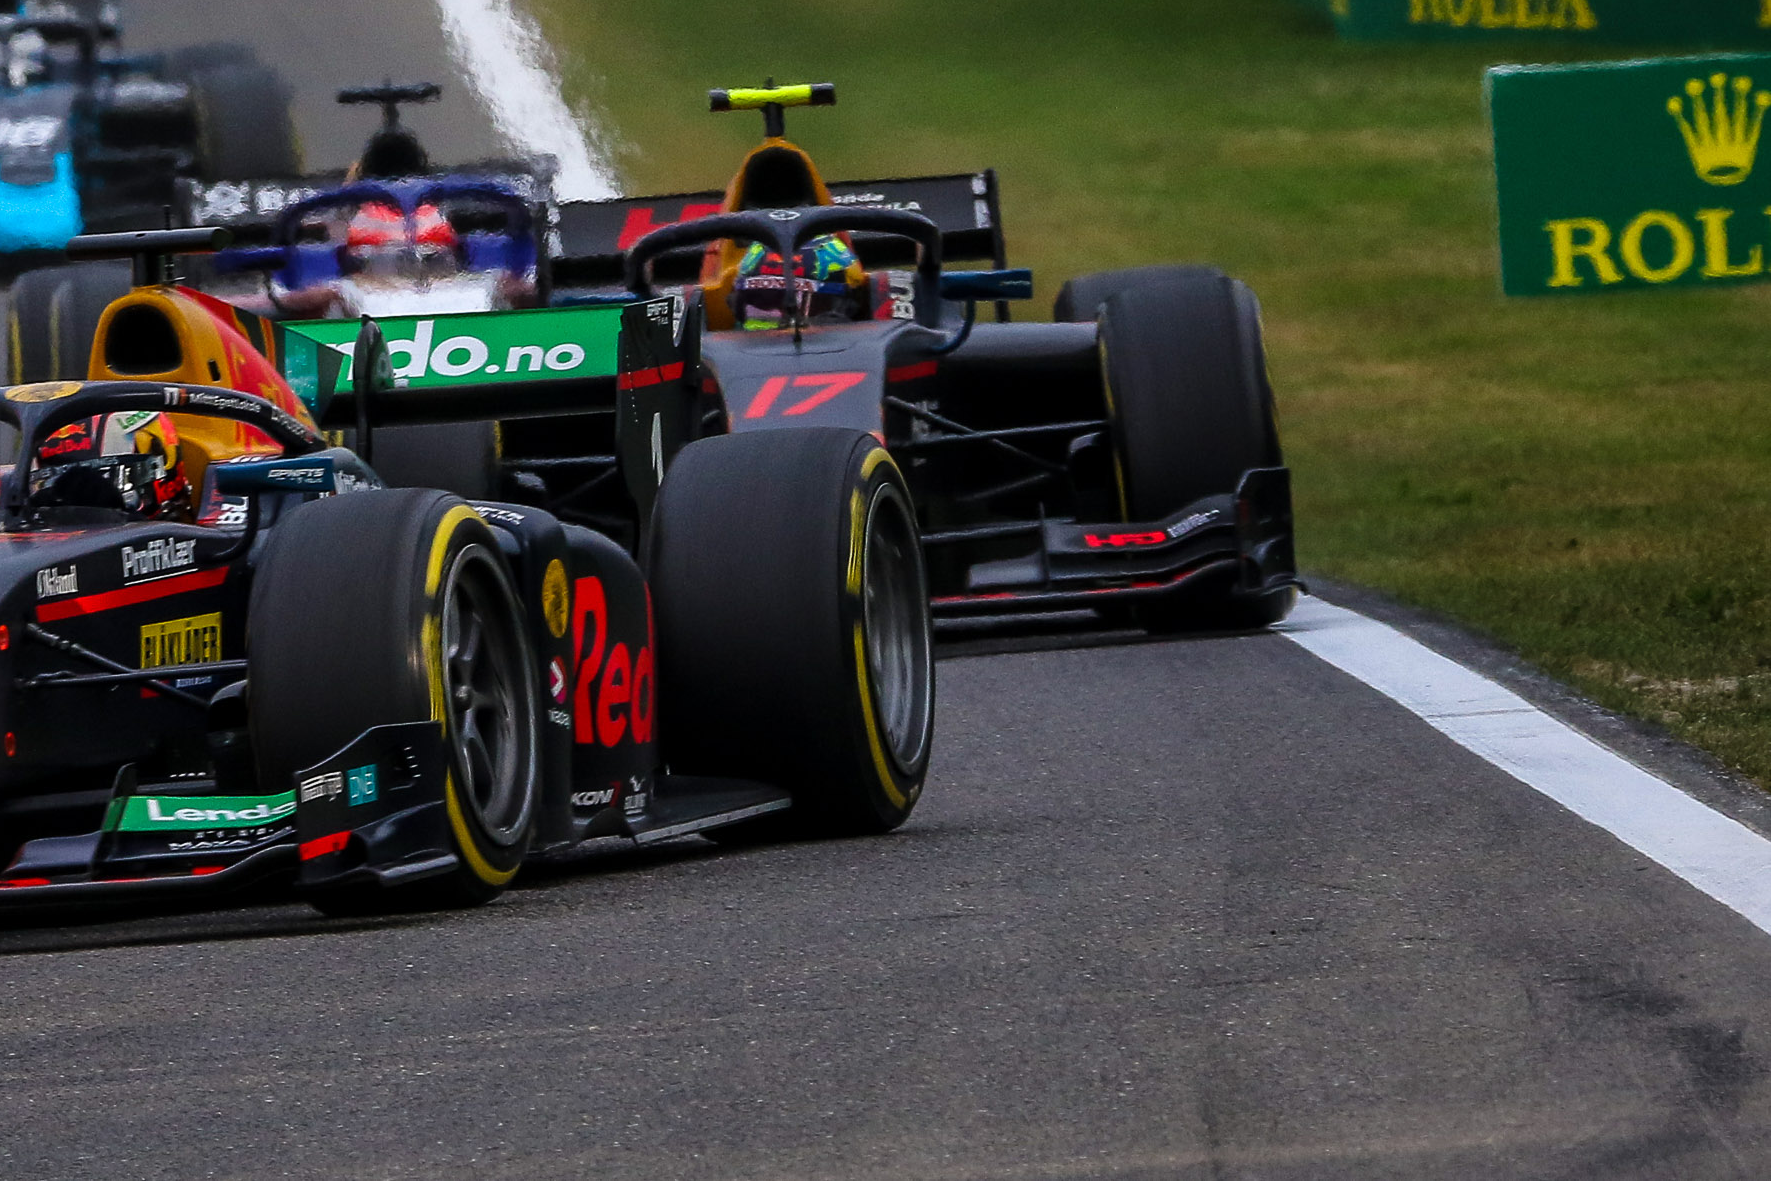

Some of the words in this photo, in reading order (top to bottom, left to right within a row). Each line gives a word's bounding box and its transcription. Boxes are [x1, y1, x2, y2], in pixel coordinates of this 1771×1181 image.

[1541, 207, 1771, 288] ROL
[744, 372, 868, 419] 17
[573, 575, 653, 748] Red
